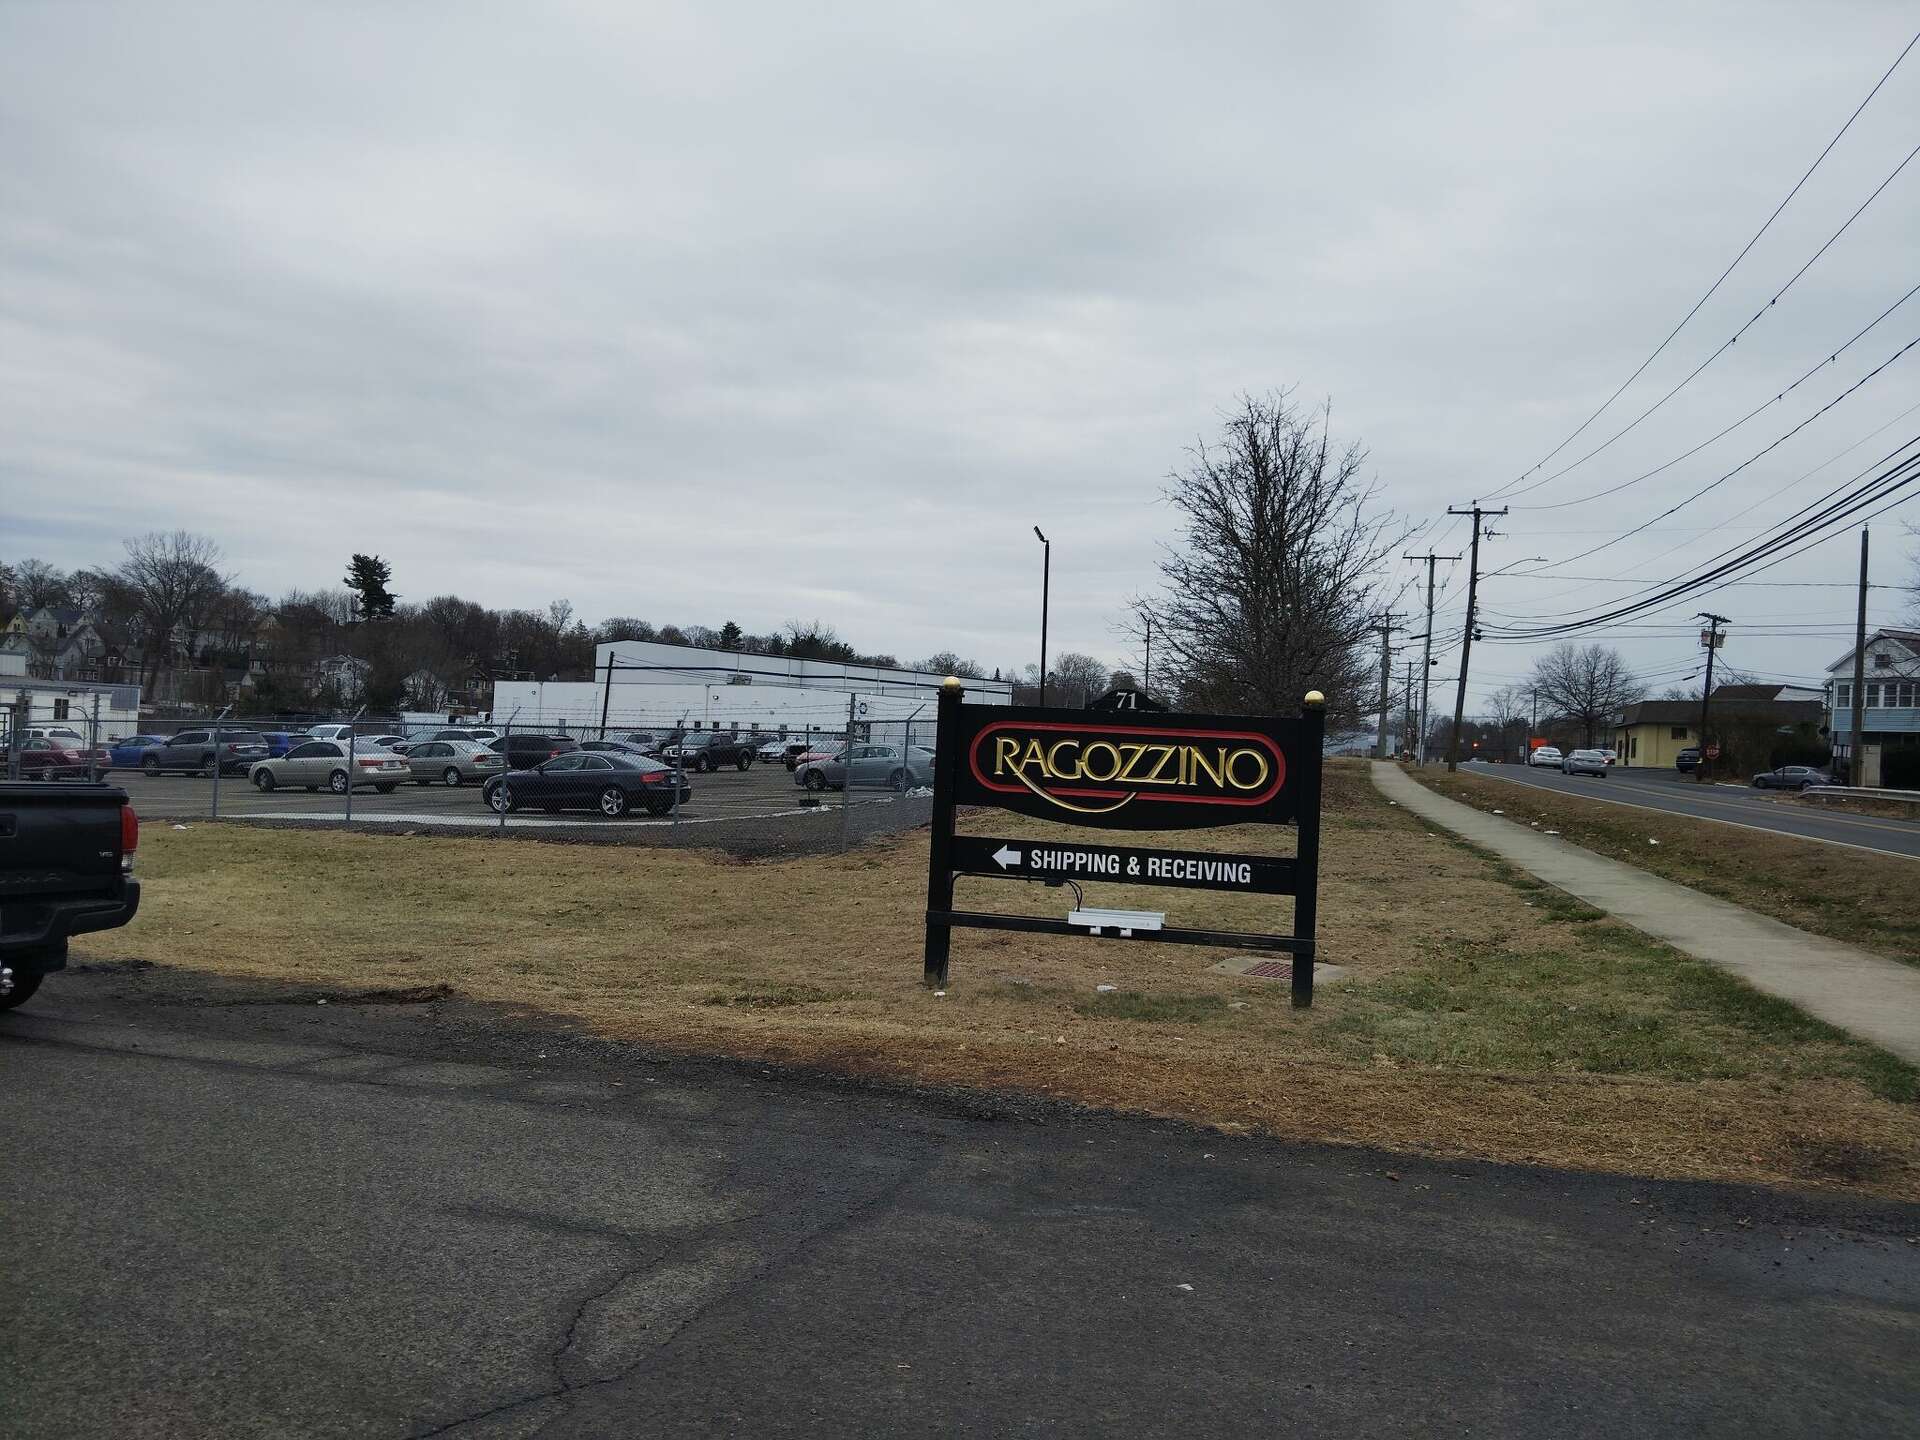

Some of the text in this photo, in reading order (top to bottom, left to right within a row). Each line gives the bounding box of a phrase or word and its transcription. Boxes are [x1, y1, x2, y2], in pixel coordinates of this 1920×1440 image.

[1116, 692, 1137, 709] 71
[994, 737, 1268, 812] RAGOZZINO
[1031, 850, 1251, 883] SHIPPING & RECEIVING
